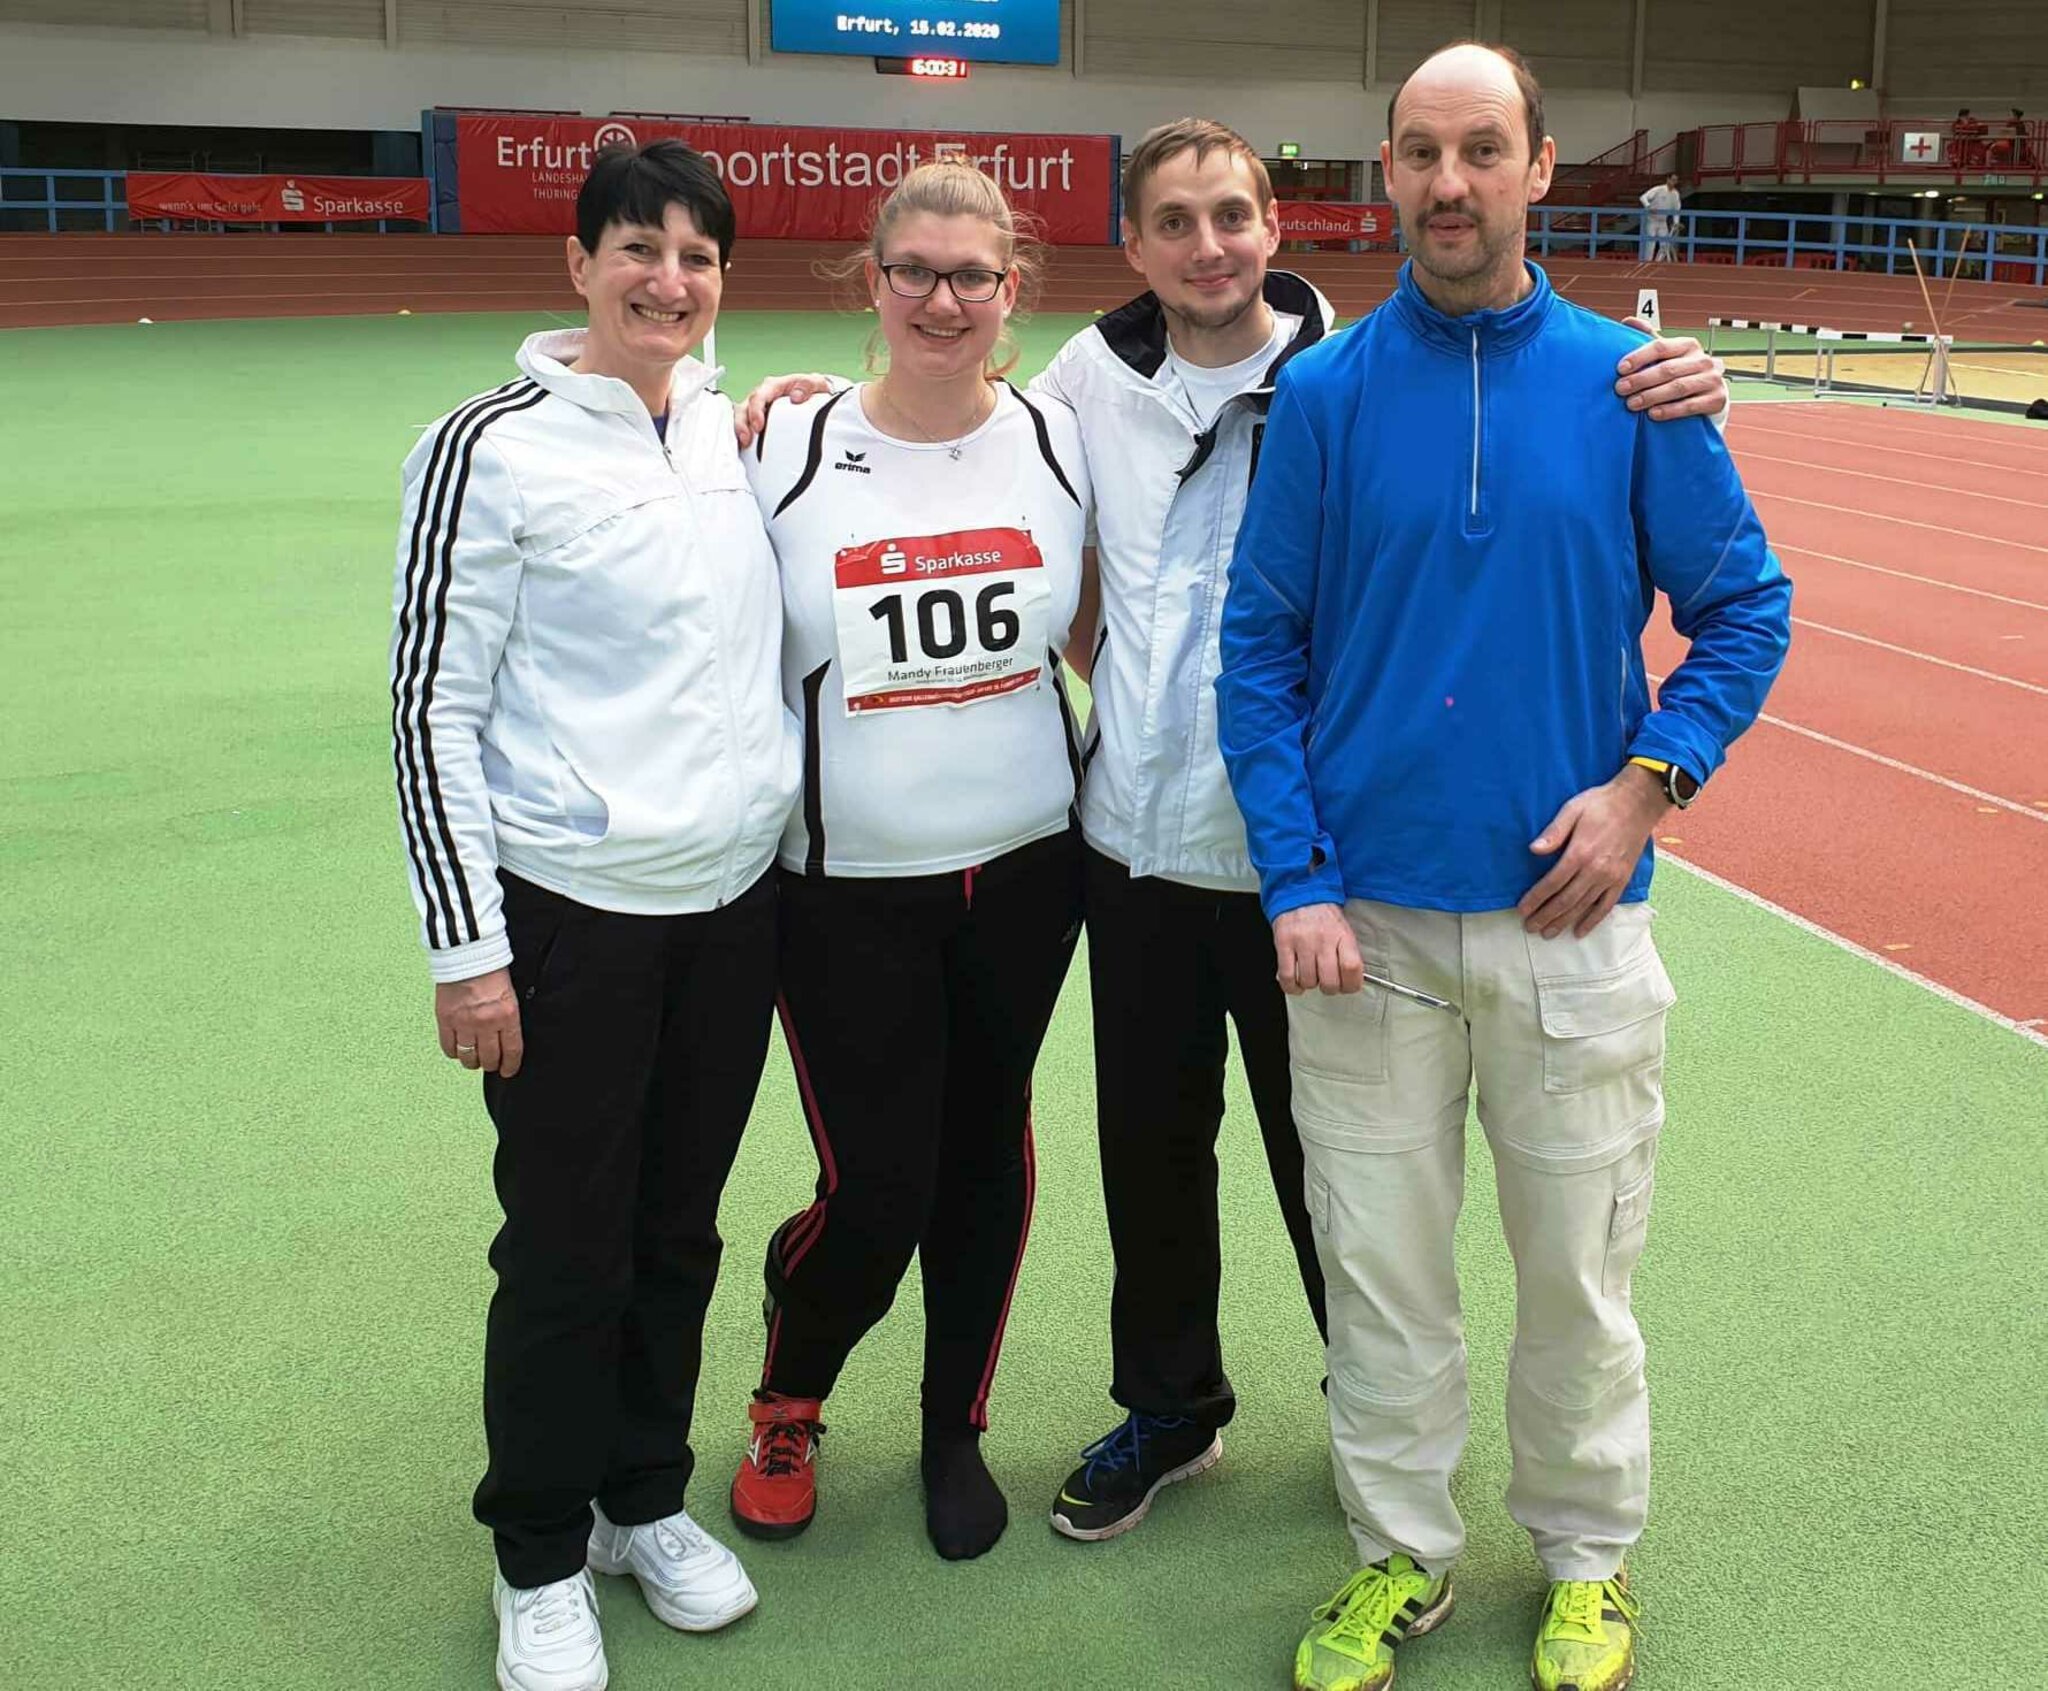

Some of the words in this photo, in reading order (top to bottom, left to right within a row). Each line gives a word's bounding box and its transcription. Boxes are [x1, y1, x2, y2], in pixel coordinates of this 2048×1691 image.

[837, 15, 899, 35] Erfurt,
[497, 136, 592, 169] Erfurt
[702, 142, 921, 188] ortstadt
[531, 172, 588, 184] LANDESHA
[534, 188, 579, 200] THÜRING
[313, 195, 403, 216] Sparkasse
[1279, 218, 1354, 232] eutschland.
[1641, 299, 1654, 318] 4
[835, 461, 871, 474] erima
[915, 550, 1002, 574] Sparkasse
[868, 581, 1020, 664] 106
[888, 666, 931, 681] Mandy
[935, 657, 1013, 676] Frauenberger
